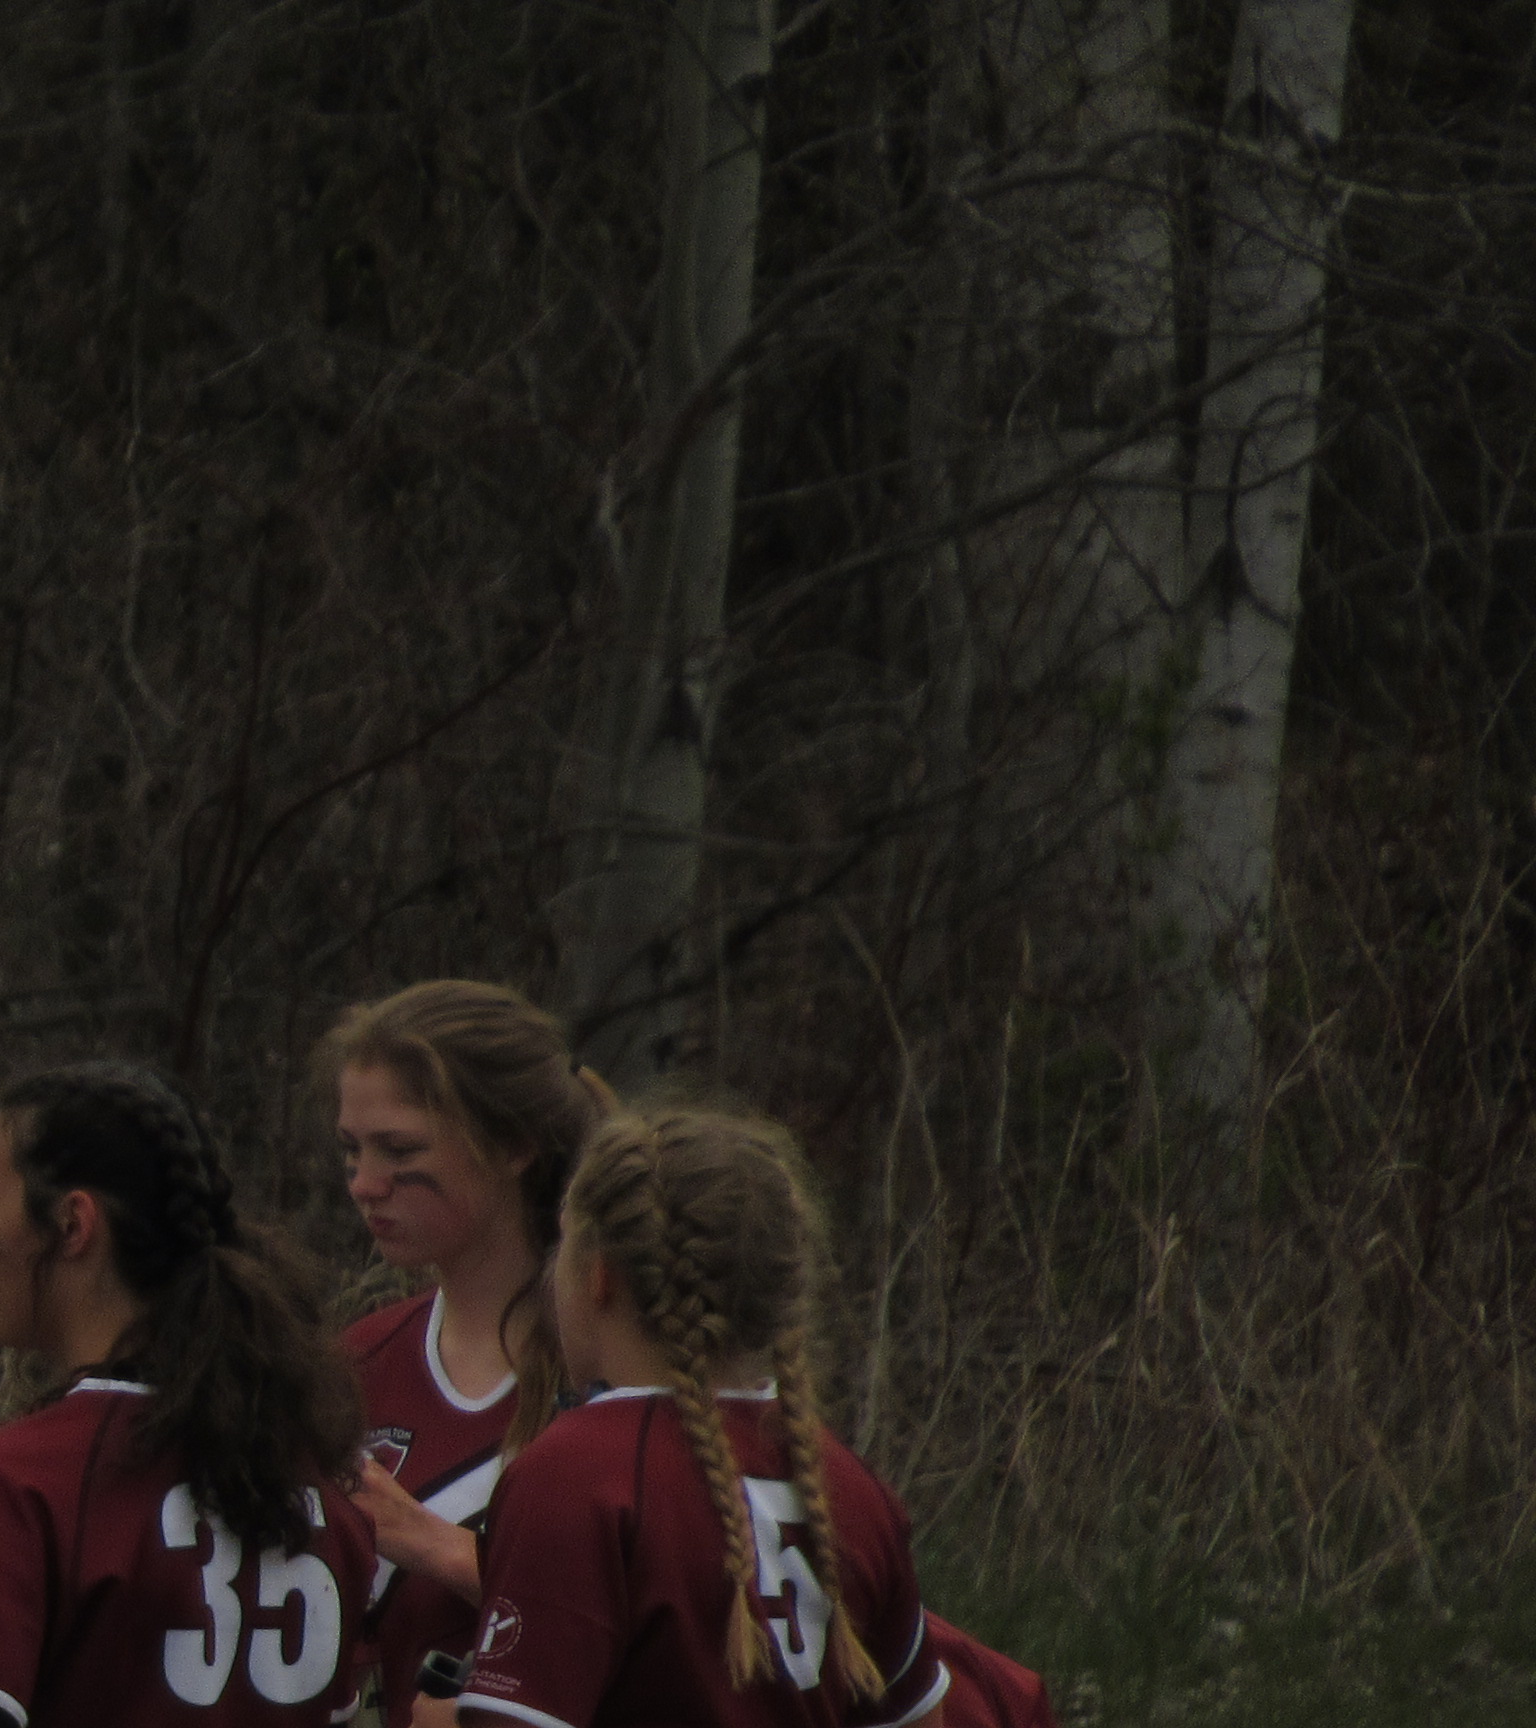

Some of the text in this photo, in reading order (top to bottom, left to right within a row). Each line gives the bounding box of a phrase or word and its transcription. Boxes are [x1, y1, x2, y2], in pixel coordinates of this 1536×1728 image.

[366, 1426, 413, 1441] AMILTON
[161, 1481, 343, 1706] 35
[742, 1476, 833, 1690] 5
